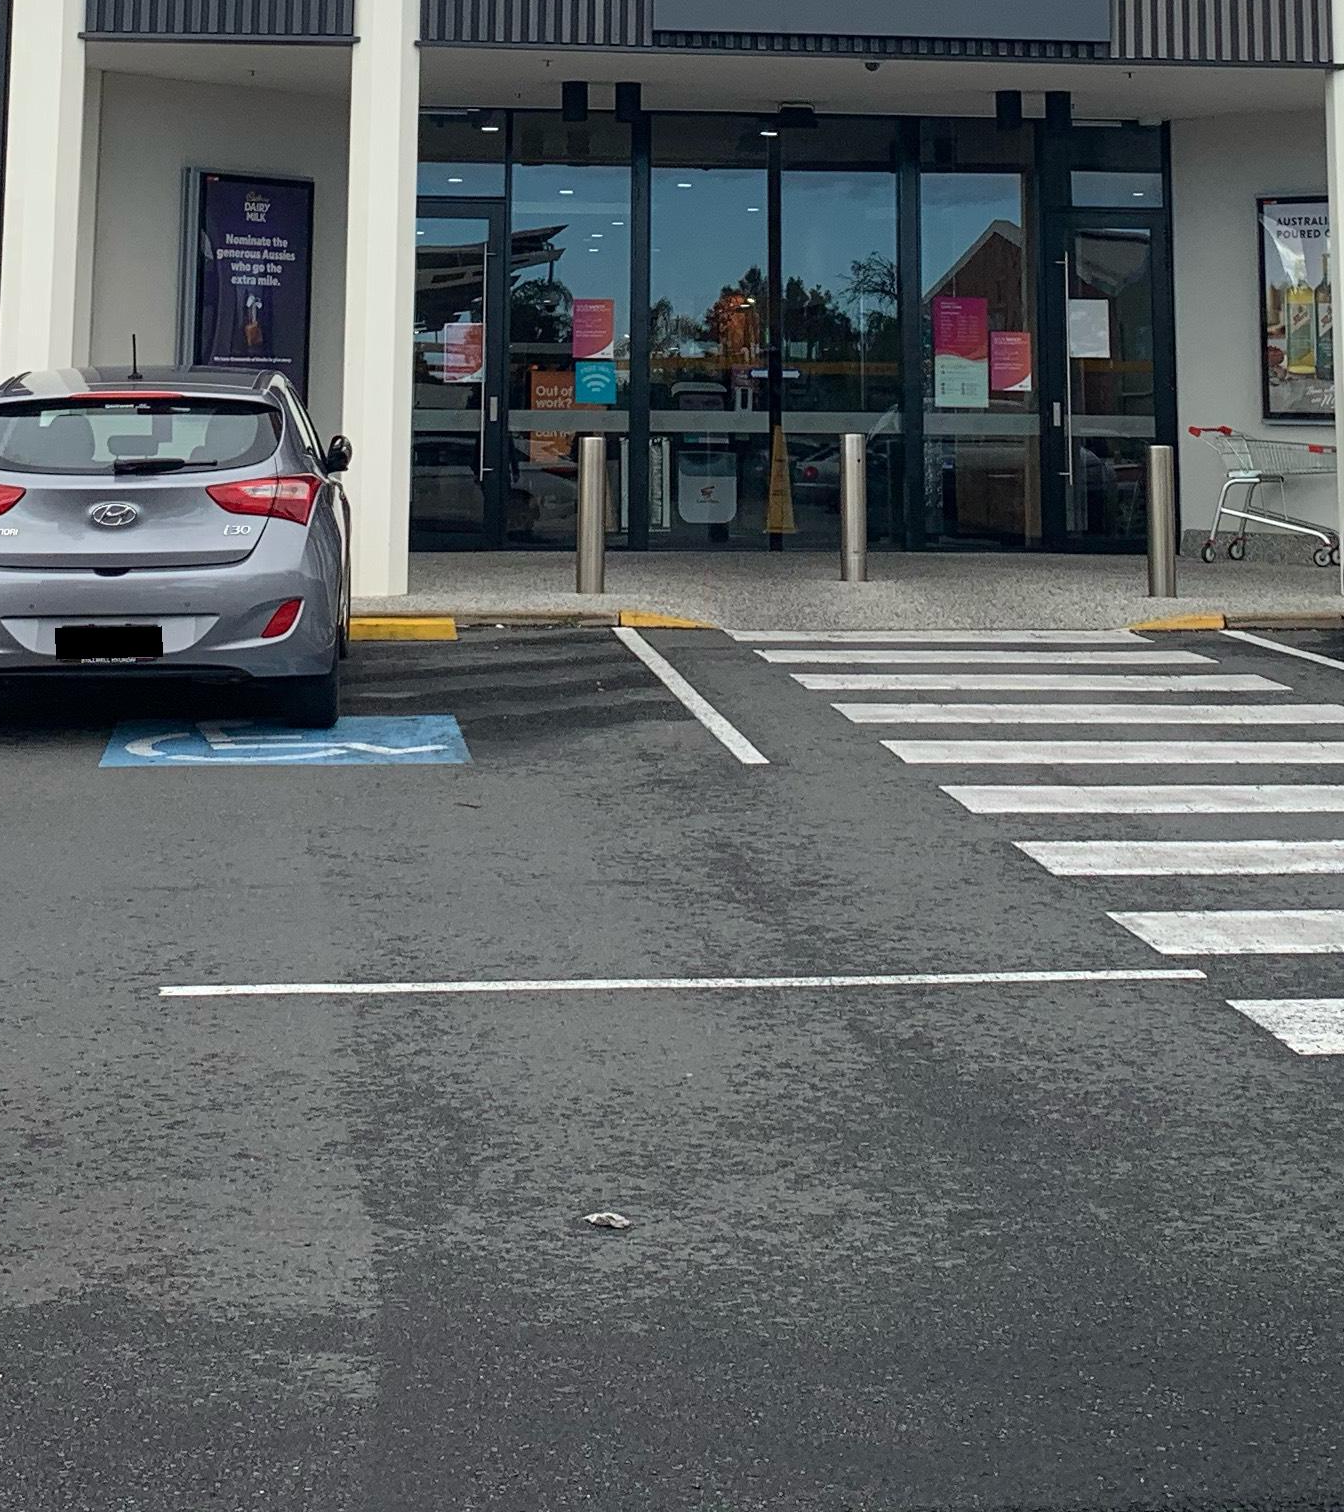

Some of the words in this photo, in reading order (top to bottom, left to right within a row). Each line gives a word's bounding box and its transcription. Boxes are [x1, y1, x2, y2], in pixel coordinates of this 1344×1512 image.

[244, 202, 271, 212] DAIRY
[246, 212, 266, 223] MILK
[1277, 216, 1330, 226] AUSTRALI
[1276, 229, 1321, 239] POURED
[225, 233, 272, 247] Nominate
[272, 237, 288, 248] the
[216, 249, 261, 260] generous
[262, 249, 296, 261] Aussies
[230, 261, 251, 272] who
[252, 264, 265, 274] go
[266, 263, 282, 273] the
[230, 274, 256, 285] extra
[257, 275, 281, 286] mile.
[536, 386, 558, 396] Out
[560, 386, 574, 397] of
[535, 397, 573, 408] work?
[223, 524, 252, 536] i30
